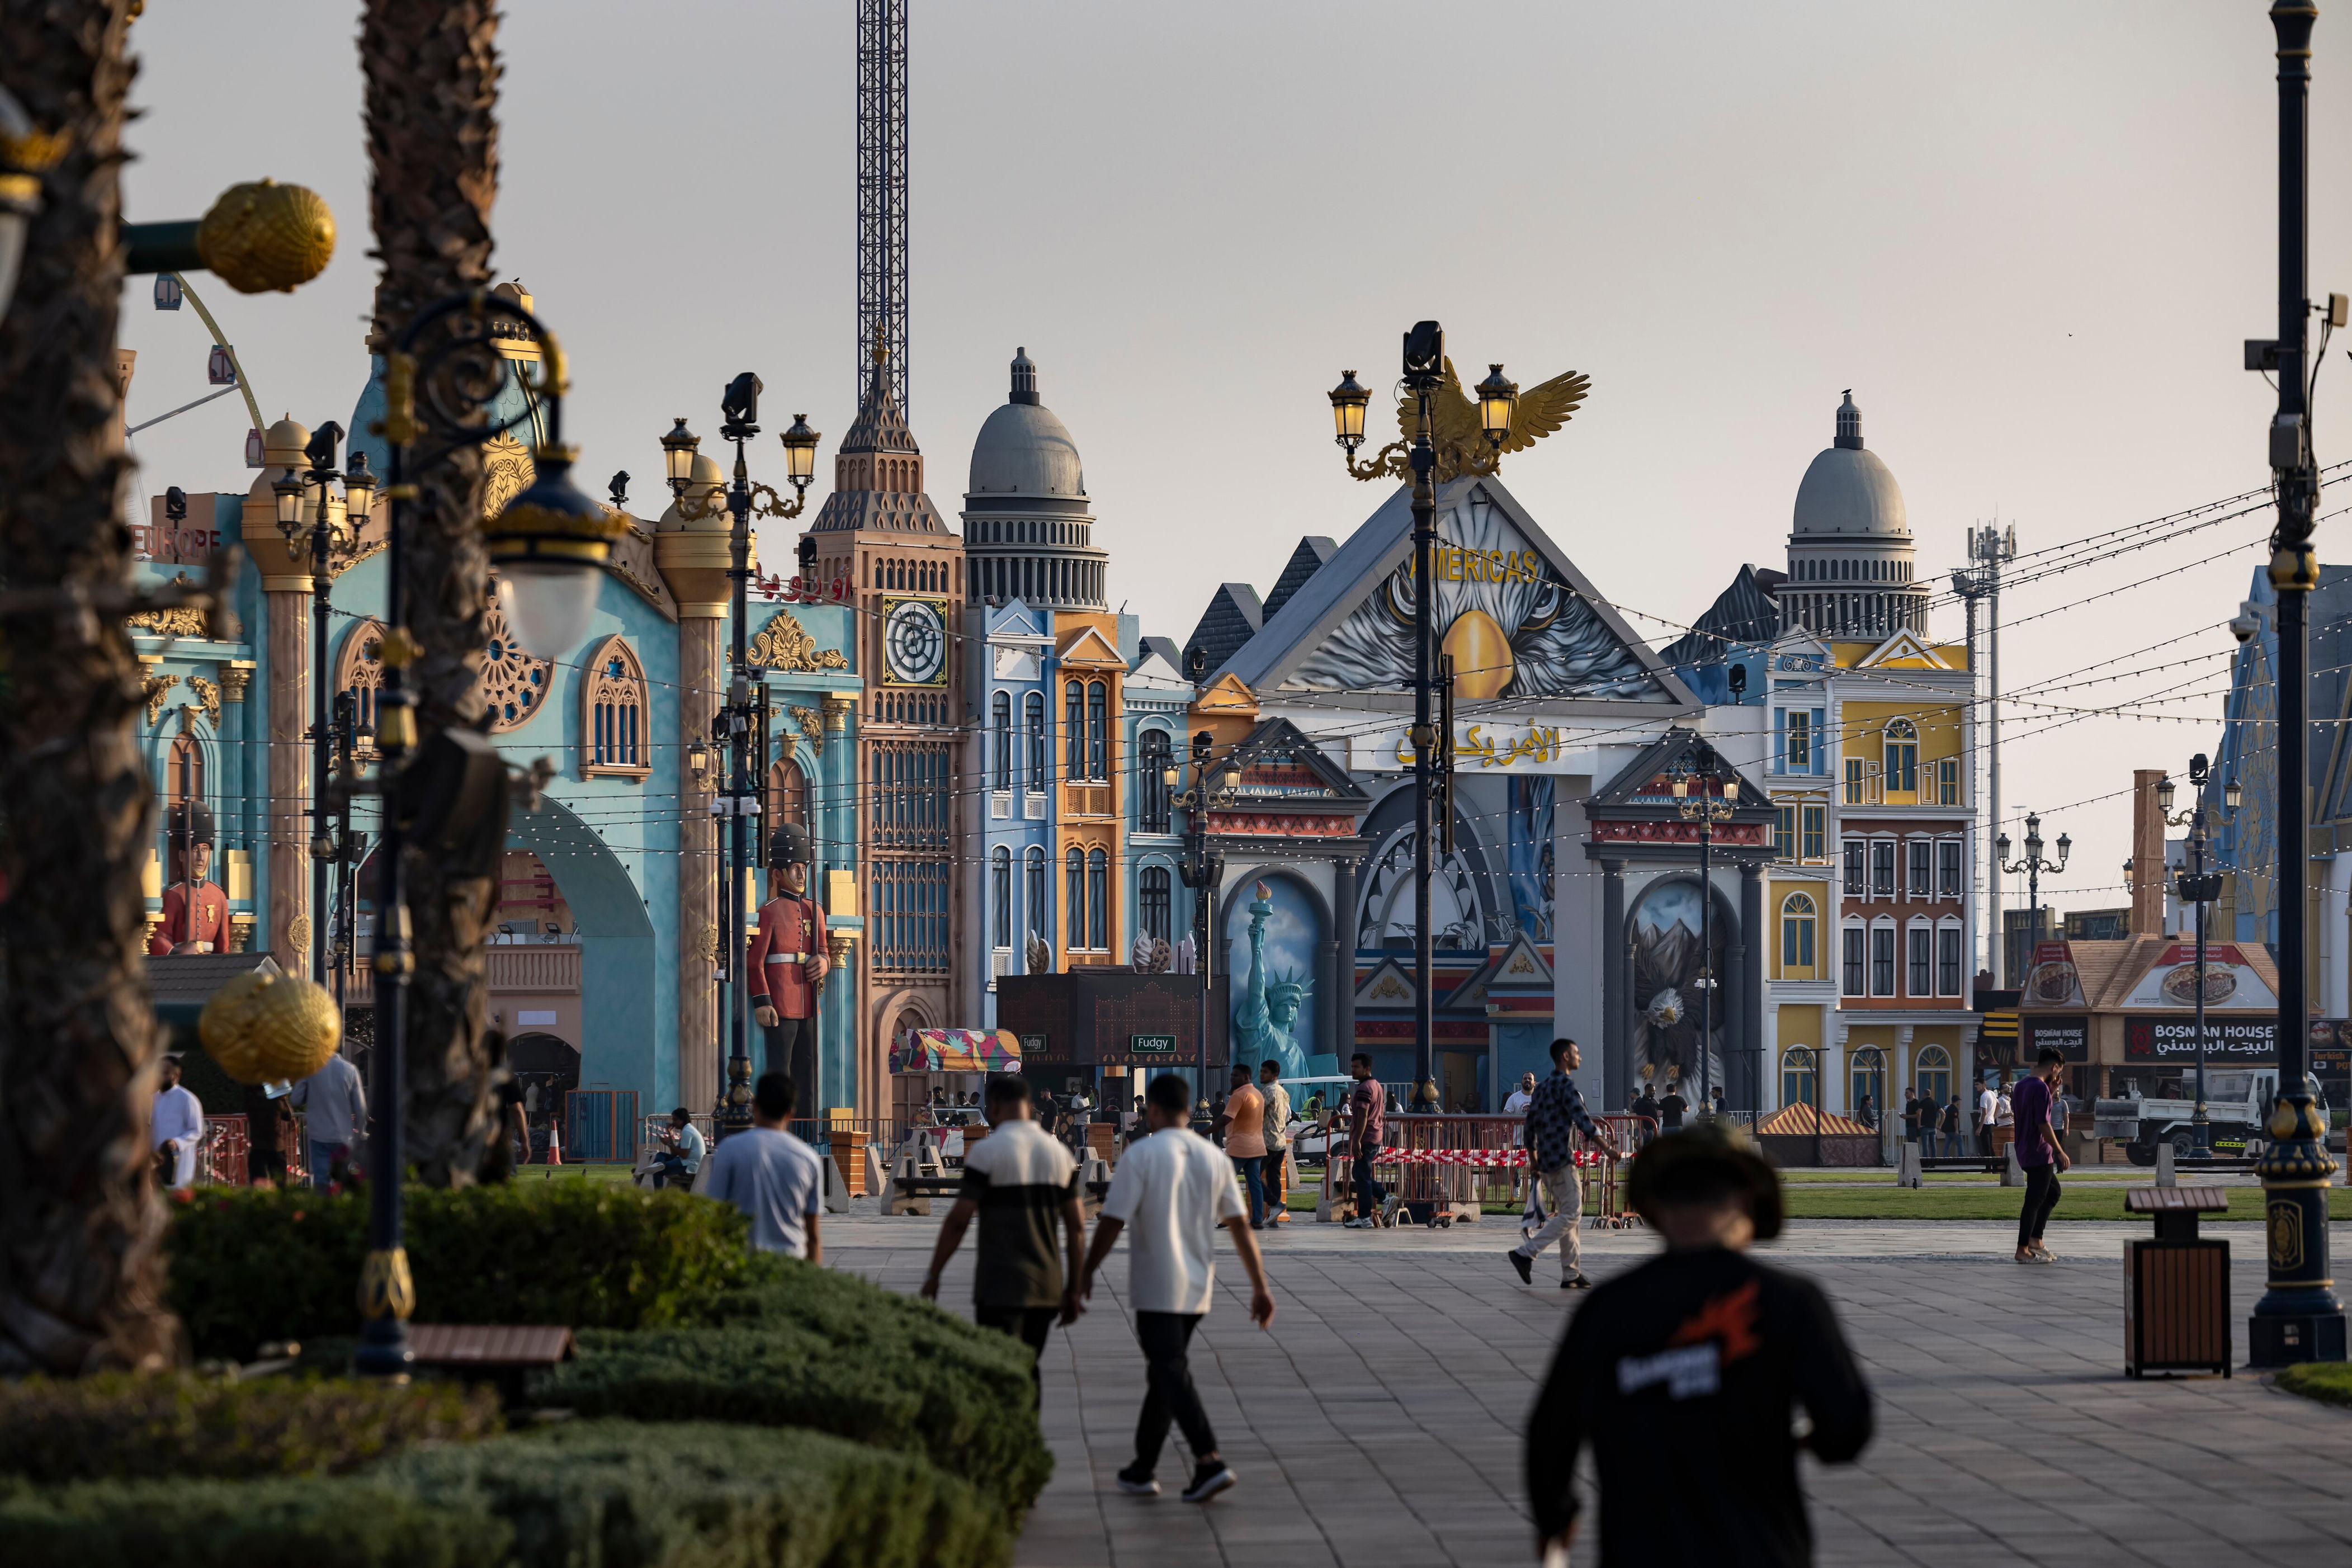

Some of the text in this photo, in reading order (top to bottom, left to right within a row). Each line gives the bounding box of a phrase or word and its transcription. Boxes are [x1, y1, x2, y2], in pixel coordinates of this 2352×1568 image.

[2155, 1025, 2274, 1038] BOSNAN HOUSE
[1024, 1037, 1041, 1049] Fudgy
[1138, 1037, 1168, 1050] Fudgy
[2228, 1040, 2274, 1055] البيت
